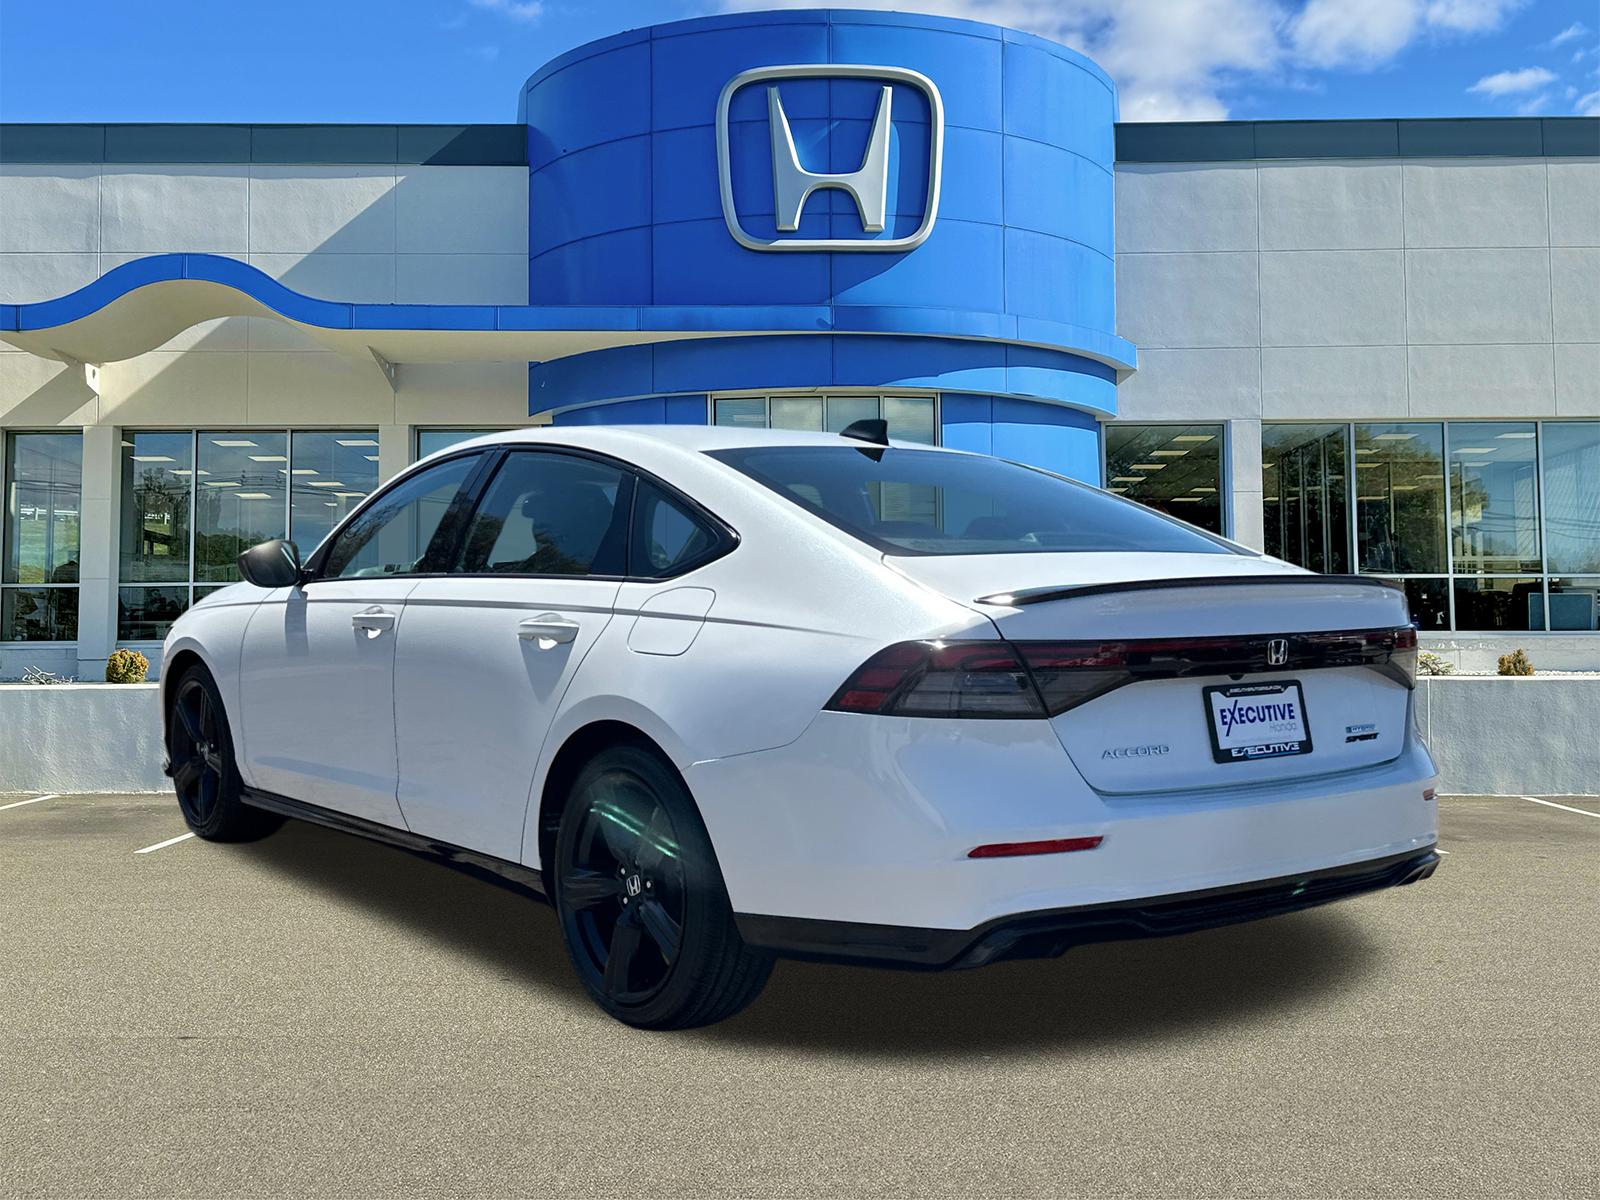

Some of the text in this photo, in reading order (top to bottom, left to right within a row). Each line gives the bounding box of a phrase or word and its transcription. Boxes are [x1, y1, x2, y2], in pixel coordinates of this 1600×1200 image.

[1220, 700, 1295, 737] EXECUTIVE
[1102, 745, 1169, 759] ACCORD
[1231, 742, 1300, 757] EXECUTIVE
